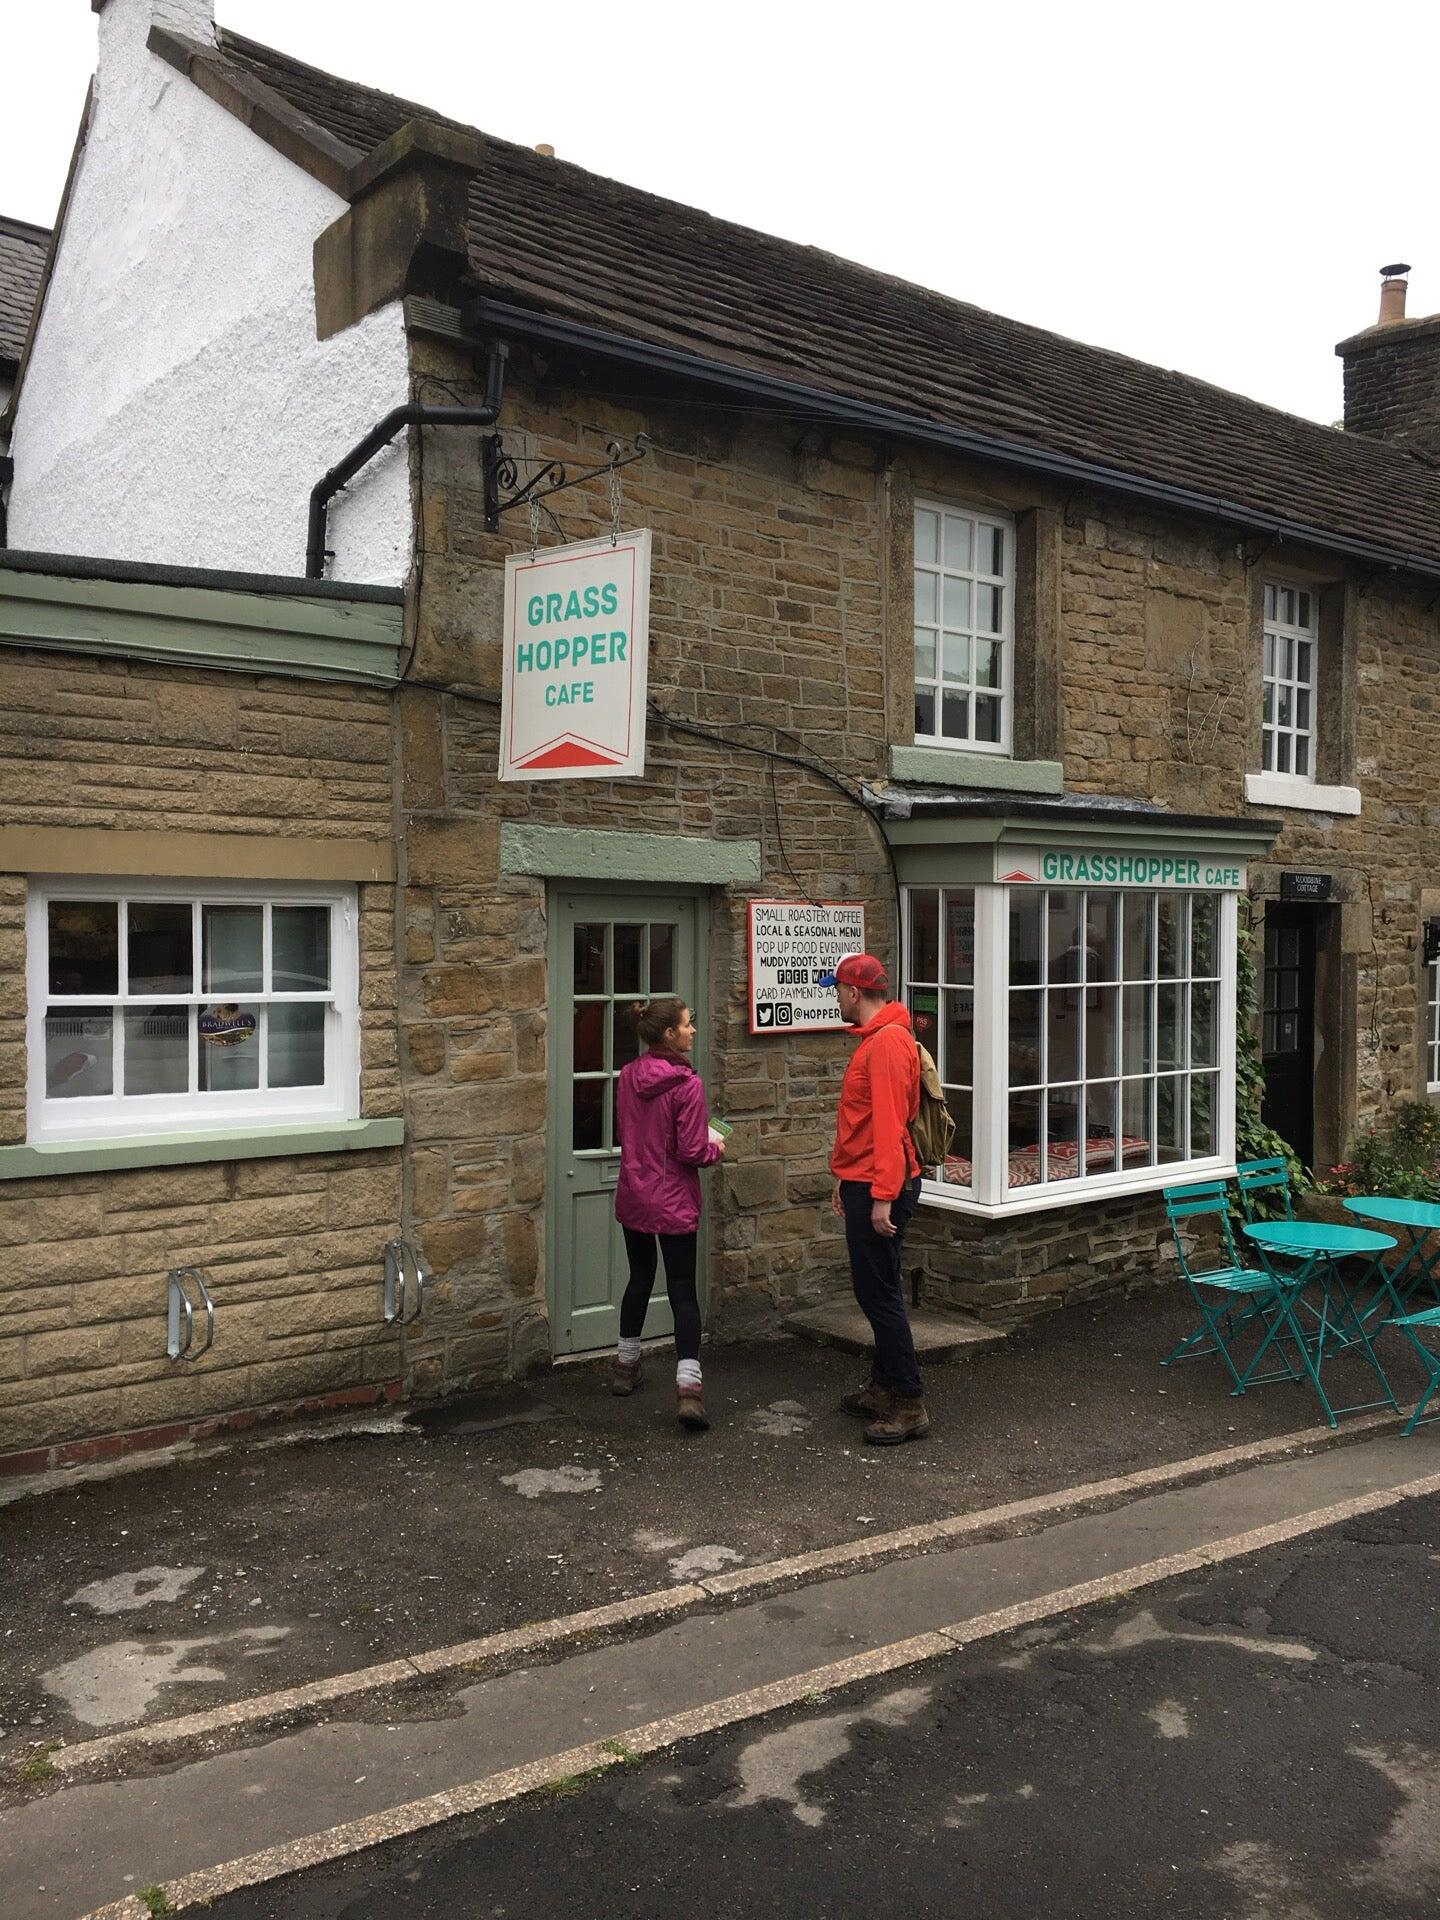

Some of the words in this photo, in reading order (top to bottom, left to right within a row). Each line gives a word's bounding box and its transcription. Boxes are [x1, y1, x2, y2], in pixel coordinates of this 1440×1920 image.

[527, 582, 618, 627] GRASS
[517, 631, 627, 673] HOPPER
[545, 681, 594, 707] CAFE
[1043, 852, 1200, 884] GRASSHOPPER
[1205, 868, 1240, 886] CAFE
[1297, 884, 1319, 892] COTTAGE
[756, 908, 786, 922] SMALL
[789, 909, 831, 923] ROASTERY
[834, 911, 861, 923] COFFEE
[756, 925, 783, 936] LOCAL
[785, 926, 791, 936] &
[794, 926, 837, 937] SEASONAL
[839, 927, 861, 938] MENU
[756, 942, 775, 953] POP
[778, 942, 789, 953] UP
[792, 942, 817, 953] FOOD
[820, 942, 861, 953] EVENINGS
[760, 956, 789, 967] MUDDY
[791, 957, 817, 967] BOOTS
[777, 969, 808, 984] FREE
[756, 988, 777, 999] CARD
[780, 987, 823, 999] PAYMENTS
[794, 1008, 840, 1020] @HOPPER
